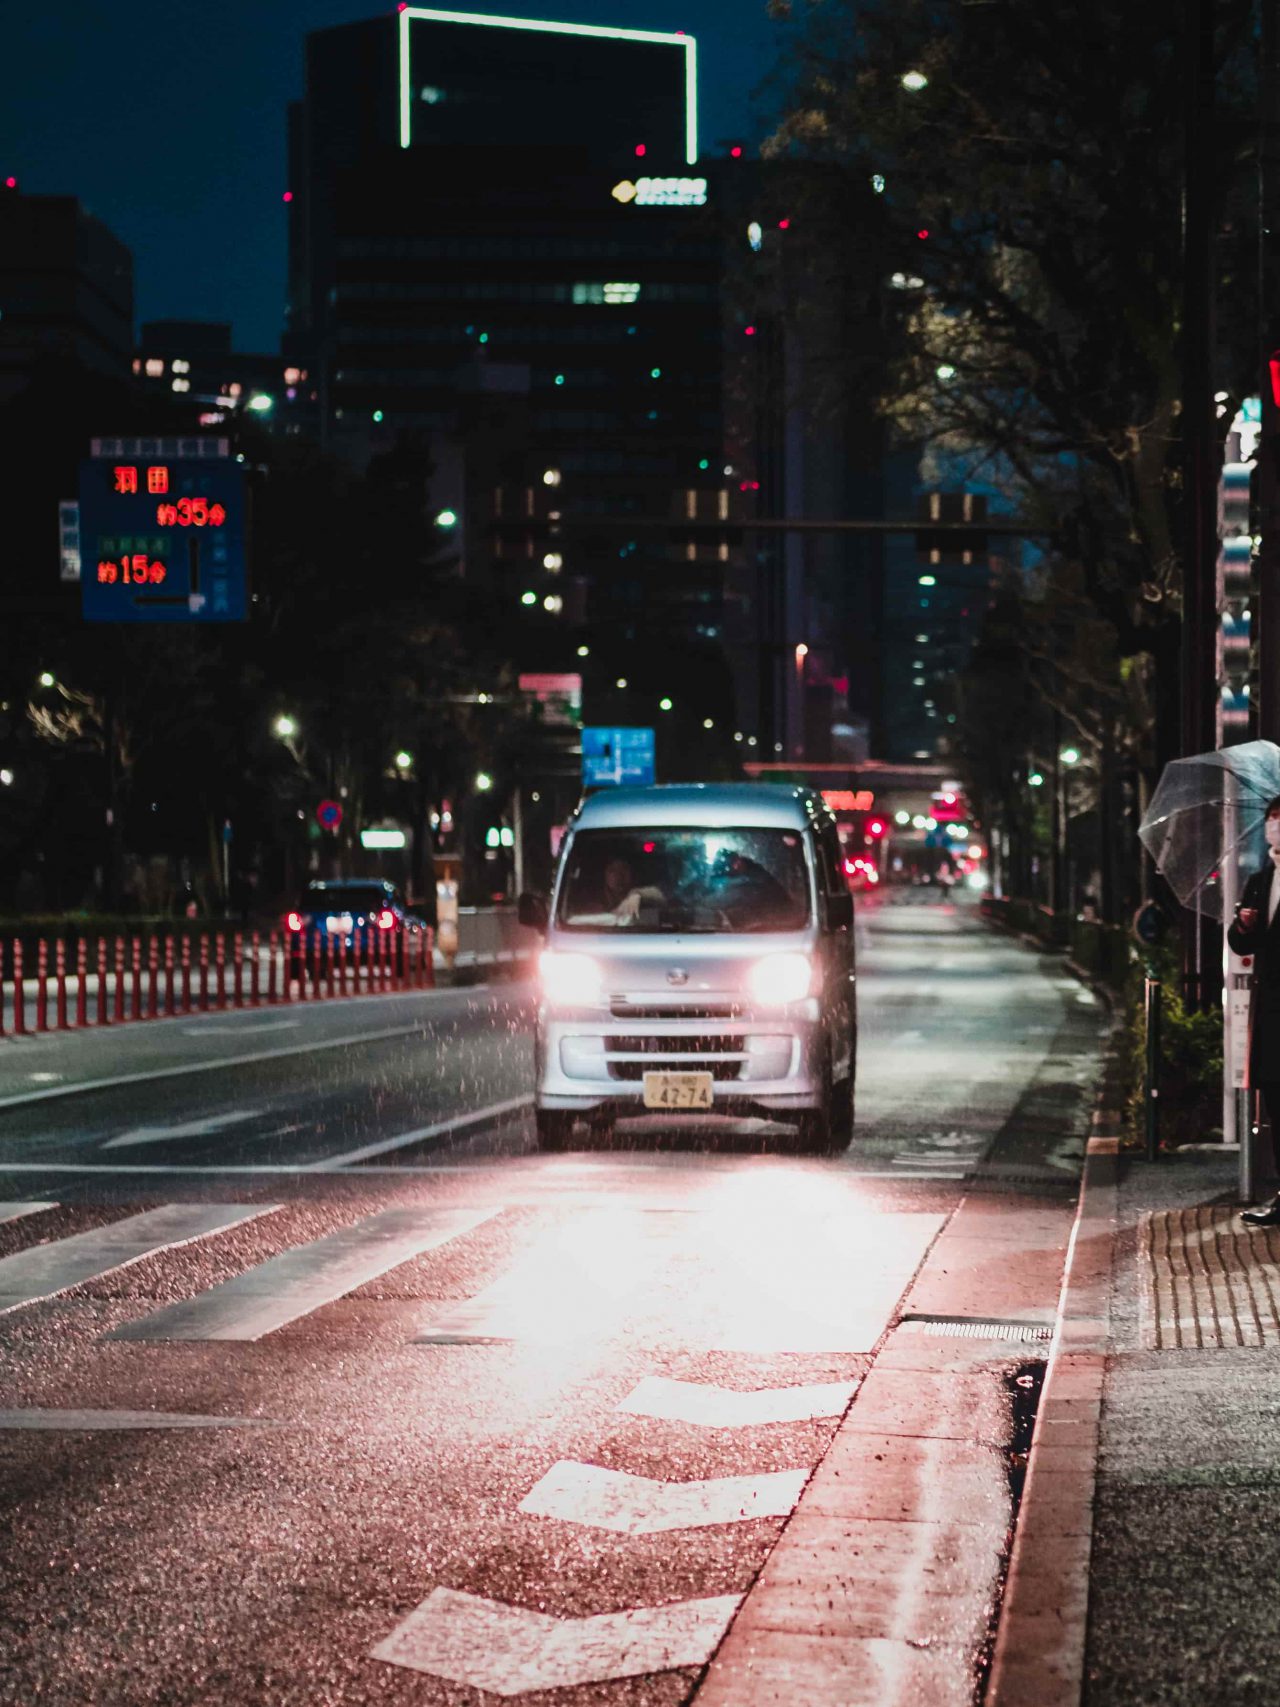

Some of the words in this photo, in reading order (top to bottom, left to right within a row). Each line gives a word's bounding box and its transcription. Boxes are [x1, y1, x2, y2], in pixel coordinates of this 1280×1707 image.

[112, 465, 170, 495] 羽田
[156, 497, 227, 527] 約35分
[97, 554, 167, 584] 約15分
